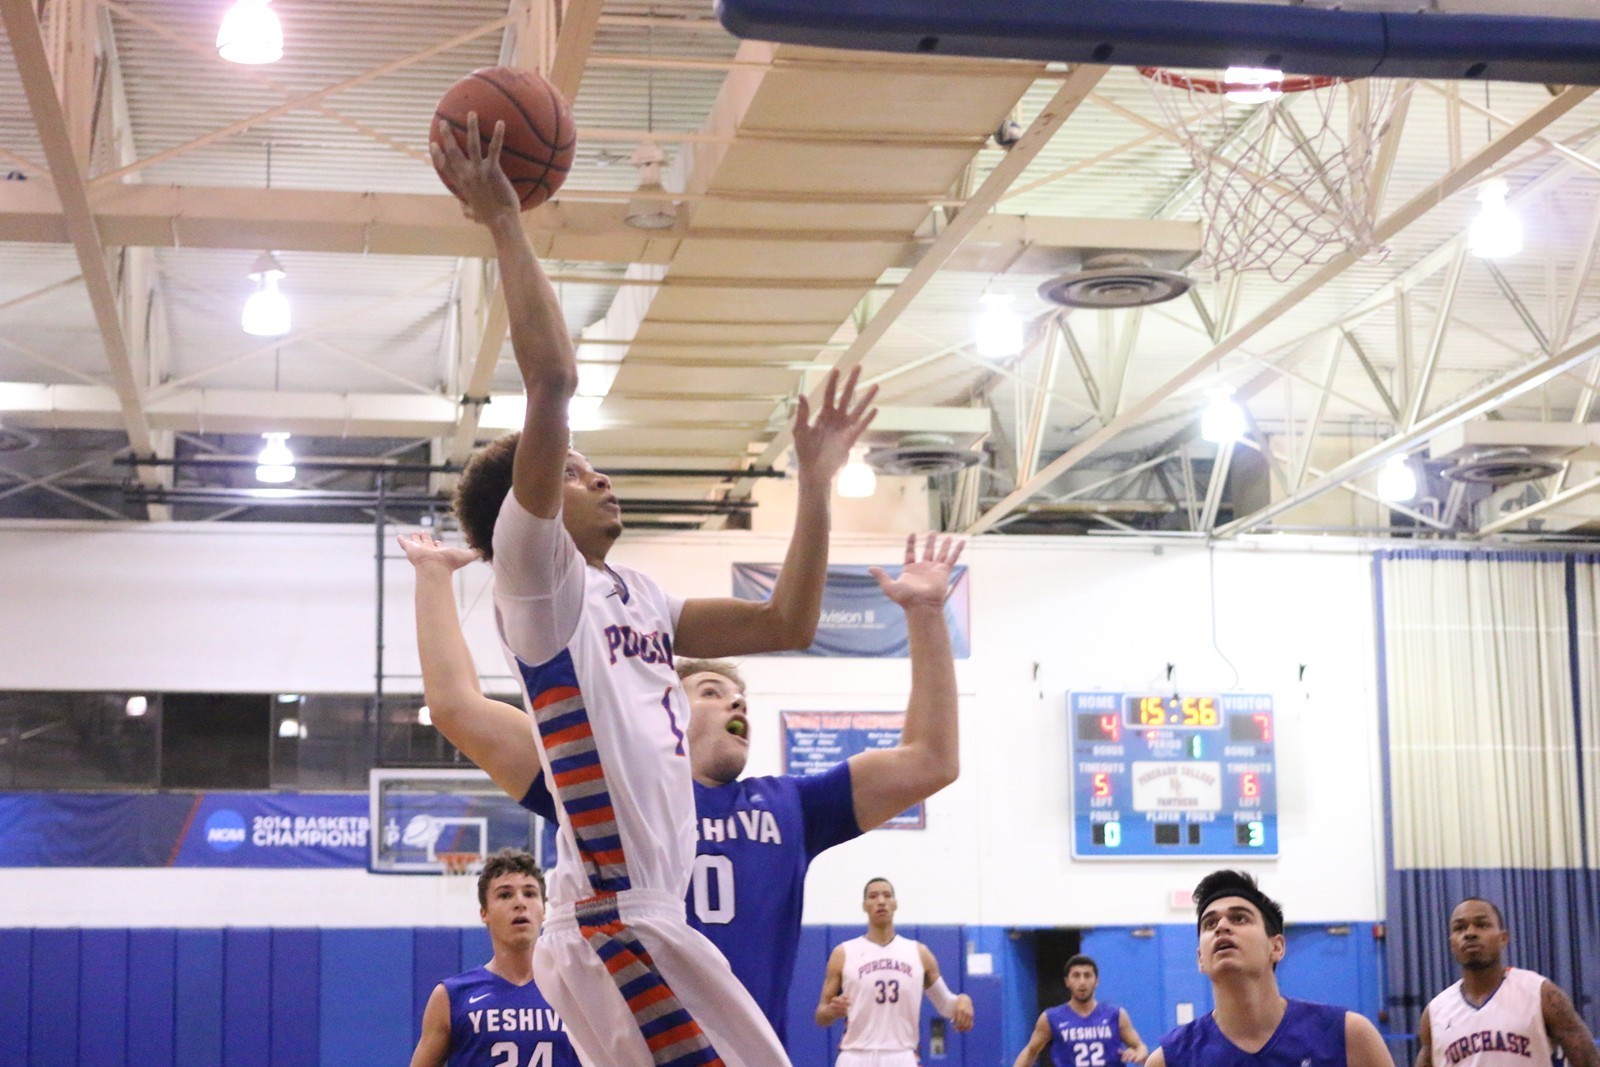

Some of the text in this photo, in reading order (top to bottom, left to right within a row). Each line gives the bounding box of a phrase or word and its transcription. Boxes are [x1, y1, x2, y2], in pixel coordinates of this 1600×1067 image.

[819, 609, 862, 623] ivision
[1078, 695, 1115, 709] HOME
[1140, 697, 1217, 726] 15:56
[1224, 696, 1271, 710] VISITOR
[1101, 713, 1120, 742] 4
[1253, 713, 1272, 743] 7
[1094, 773, 1111, 798] 5
[1242, 773, 1260, 798] 6
[252, 817, 292, 830] 2014
[1104, 822, 1121, 847] 0
[1247, 822, 1264, 847] 3
[875, 980, 900, 1004] 33
[1061, 1026, 1112, 1042] YESHIVA
[1073, 1042, 1106, 1067] 22
